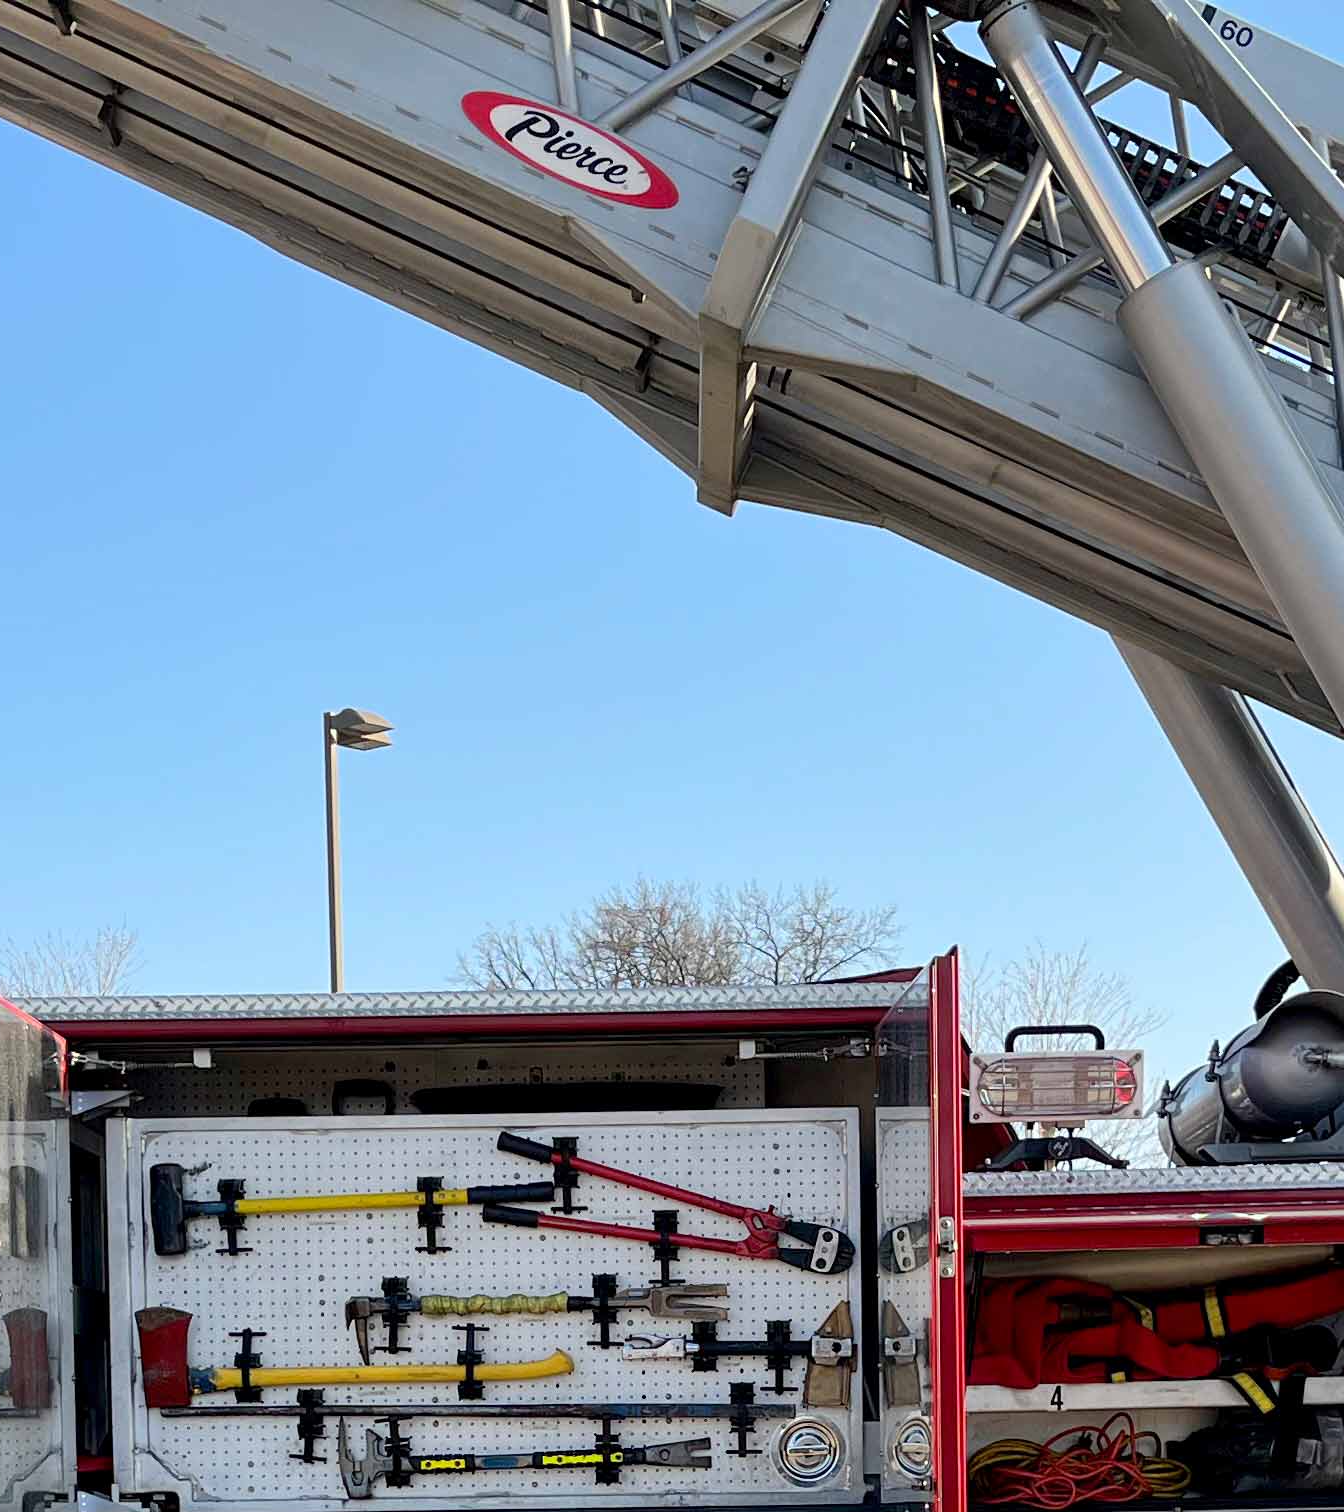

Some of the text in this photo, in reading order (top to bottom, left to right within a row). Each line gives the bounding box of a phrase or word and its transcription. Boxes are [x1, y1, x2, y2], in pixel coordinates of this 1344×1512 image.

[1220, 20, 1253, 47] 60
[505, 110, 628, 185] Pierce
[1050, 1385, 1064, 1411] 4
